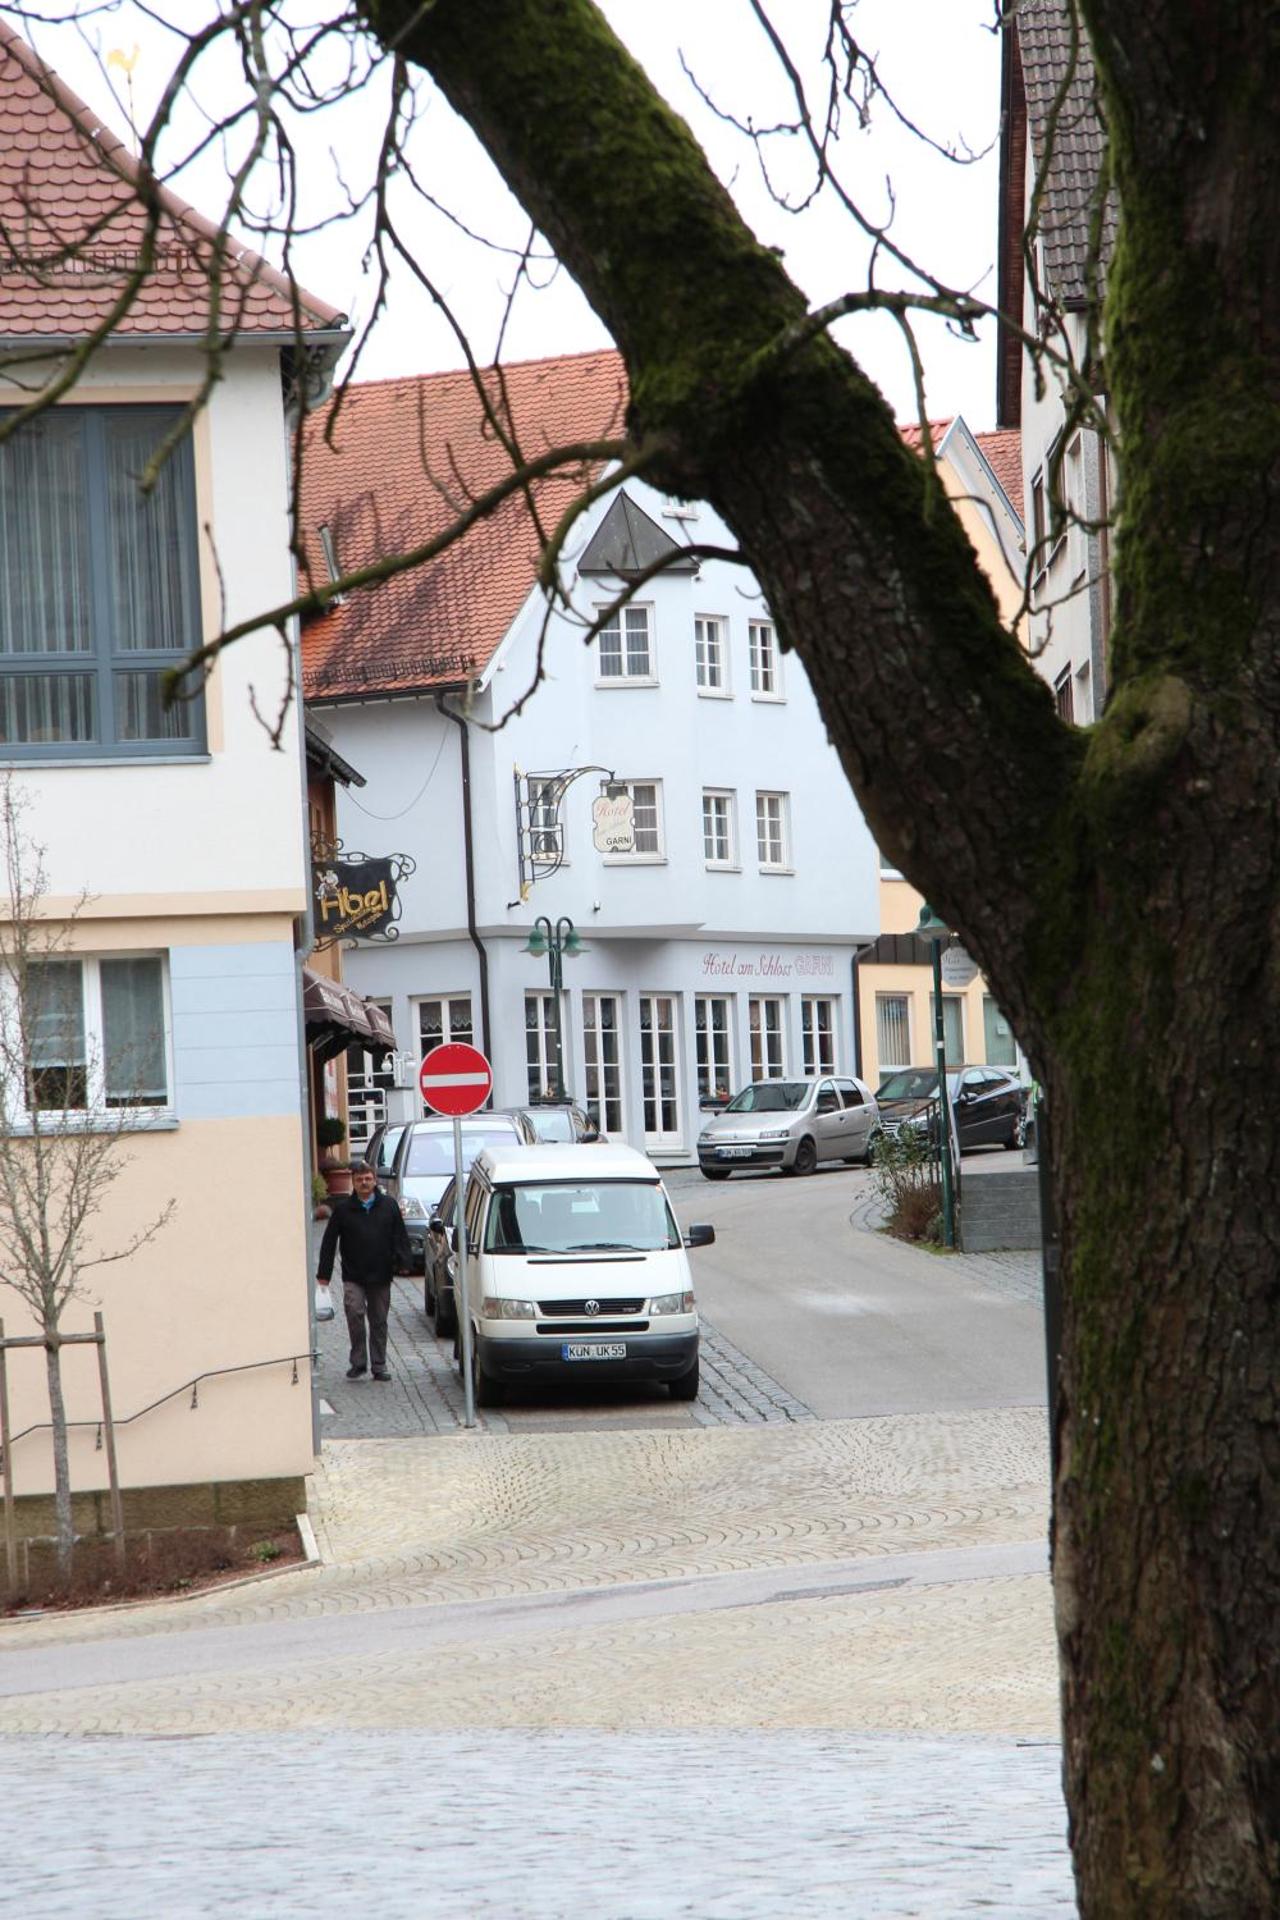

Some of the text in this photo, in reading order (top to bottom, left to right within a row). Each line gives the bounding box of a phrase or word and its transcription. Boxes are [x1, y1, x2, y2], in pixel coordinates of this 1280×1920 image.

[597, 801, 630, 817] Hotel
[606, 836, 632, 846] GARNI
[702, 953, 736, 976] Hotel
[739, 963, 754, 975] am
